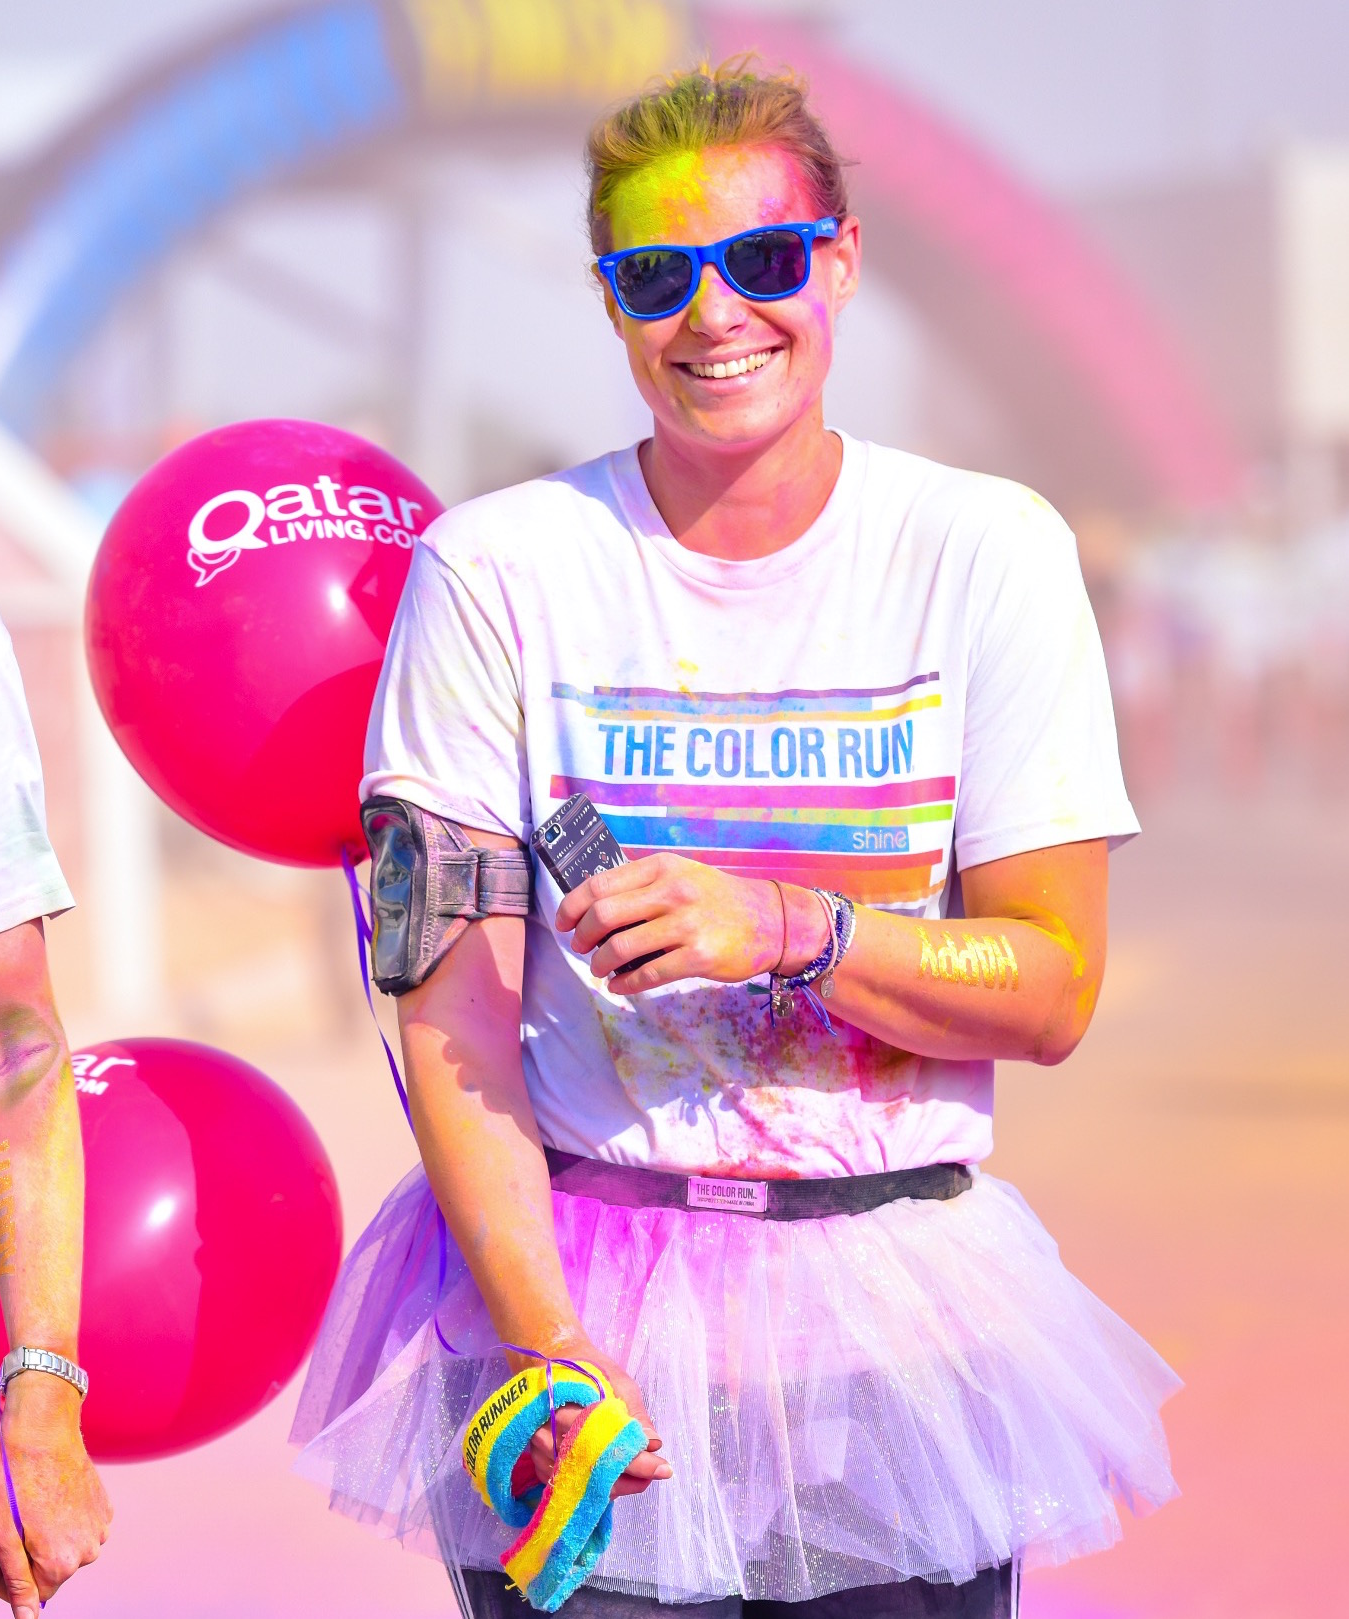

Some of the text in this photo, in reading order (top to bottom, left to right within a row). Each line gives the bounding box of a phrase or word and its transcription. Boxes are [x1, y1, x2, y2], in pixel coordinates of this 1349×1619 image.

[187, 475, 422, 554] Qatar
[599, 720, 913, 779] THE COLOR RUN
[852, 829, 907, 851] shine
[696, 1183, 710, 1196] THE
[711, 1185, 736, 1198] COLOR
[478, 1376, 528, 1437] RUNNER
